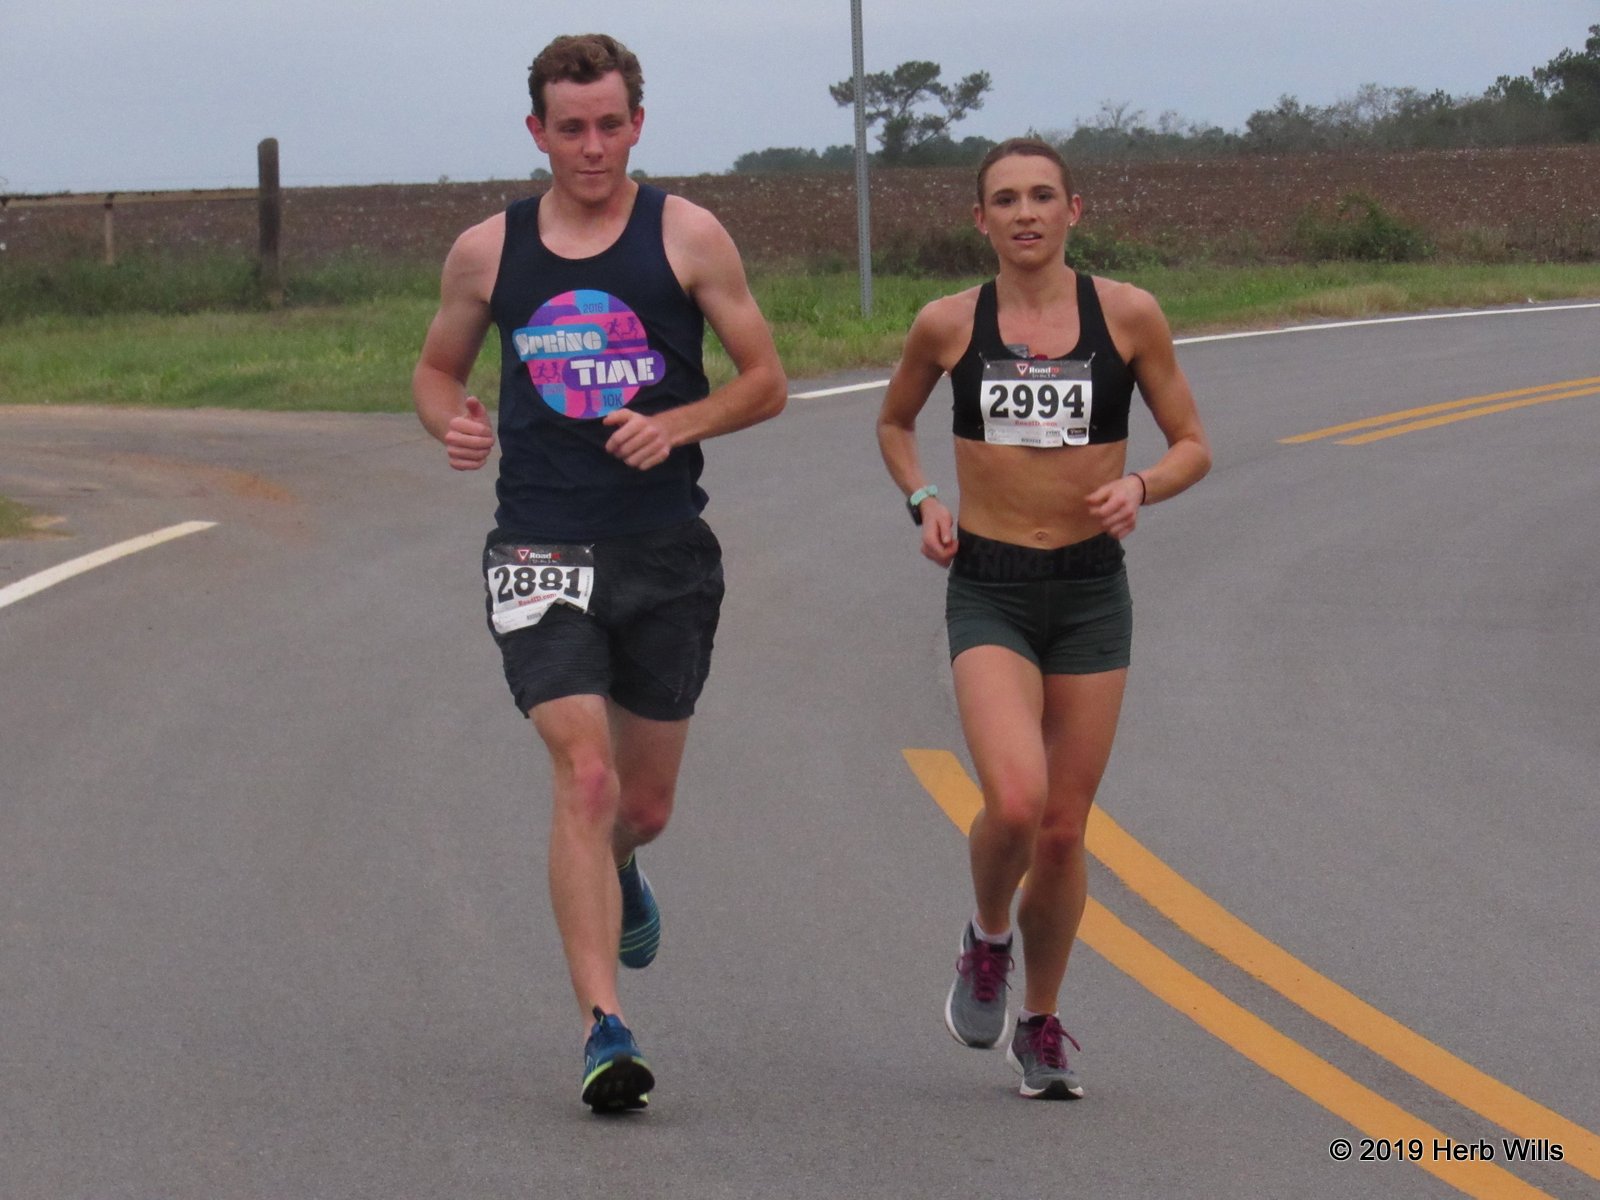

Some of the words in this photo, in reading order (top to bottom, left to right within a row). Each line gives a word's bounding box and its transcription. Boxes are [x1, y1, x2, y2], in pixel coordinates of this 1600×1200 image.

[570, 357, 655, 386] TIME
[603, 393, 624, 407] 10K
[989, 384, 1085, 419] 2994
[494, 566, 582, 604] 2881
